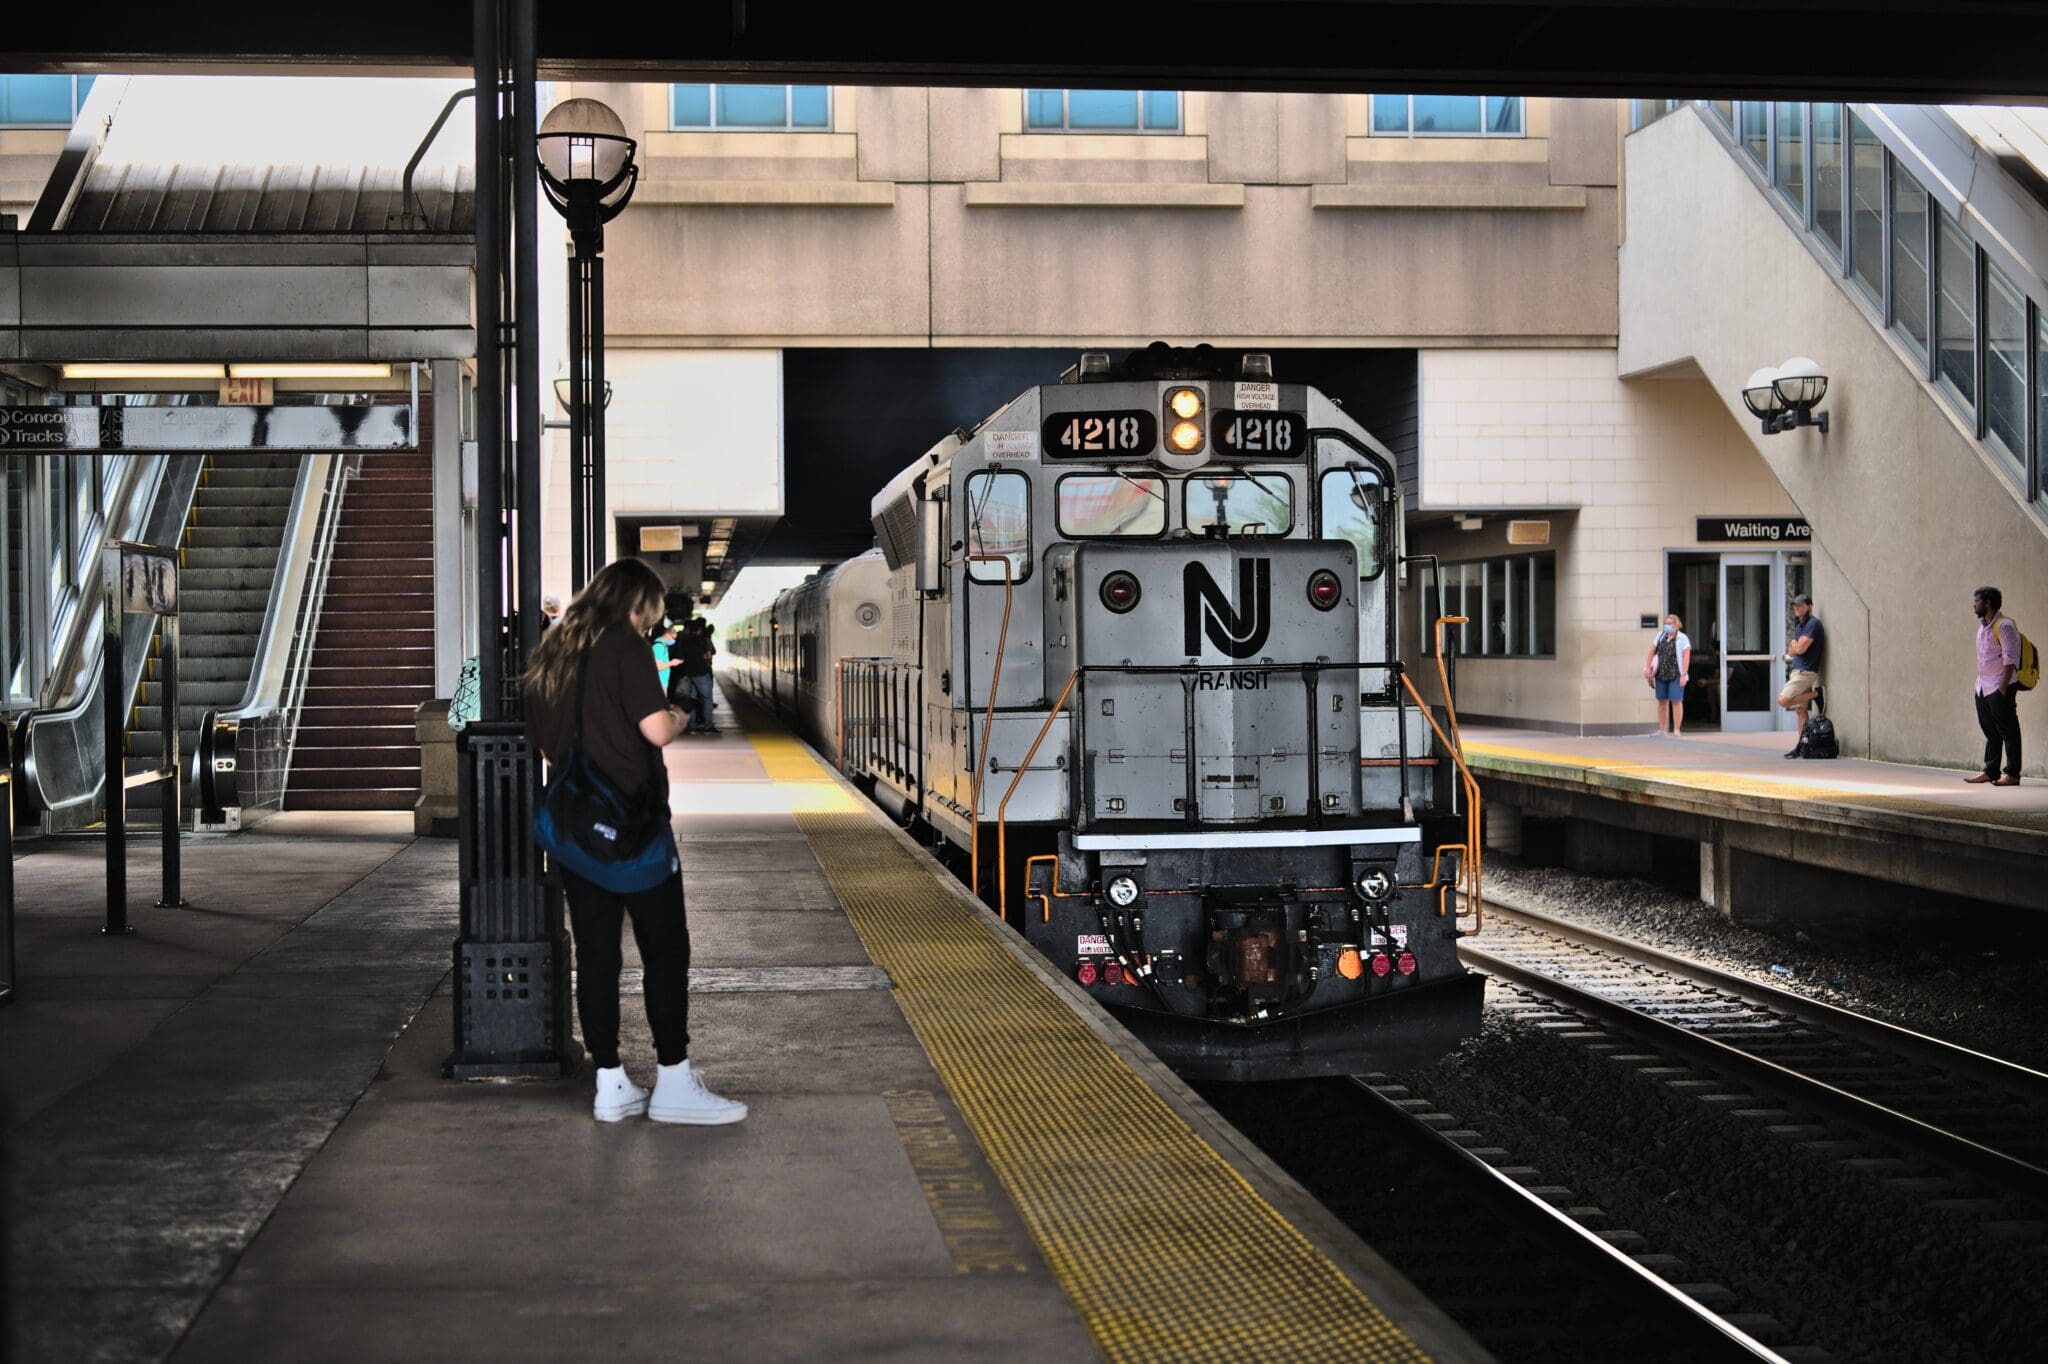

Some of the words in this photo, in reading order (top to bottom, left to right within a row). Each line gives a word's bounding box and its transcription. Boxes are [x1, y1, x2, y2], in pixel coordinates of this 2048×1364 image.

[228, 378, 264, 403] EXIT
[1241, 384, 1271, 392] DANGER
[13, 429, 64, 443] Tracks
[992, 433, 1029, 441] DANGER
[1060, 417, 1139, 450] 4218
[1225, 417, 1291, 451] 4218
[1725, 522, 1780, 540] Waiting
[1785, 523, 1810, 537] Are
[1183, 558, 1271, 659] NJ
[1199, 670, 1272, 690] RANSIT
[1080, 936, 1108, 944] DANGE
